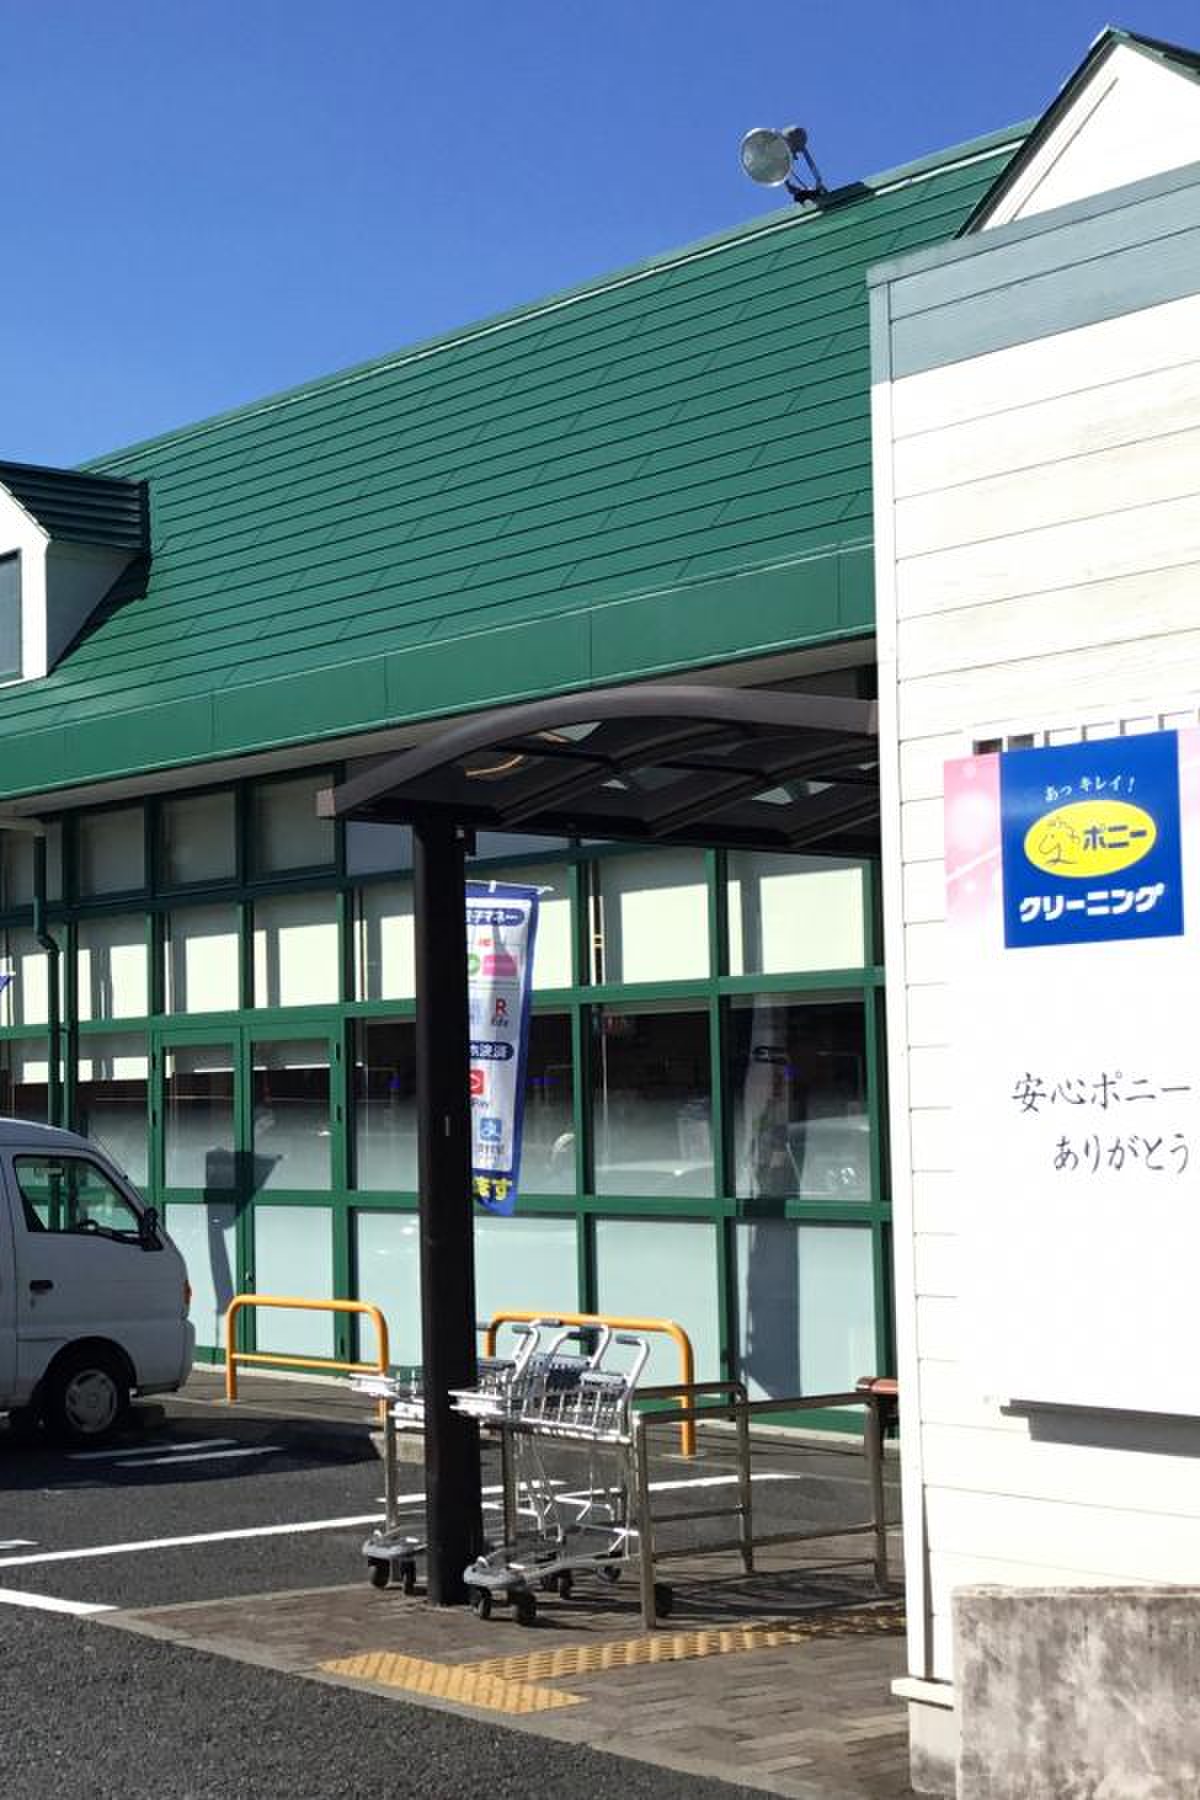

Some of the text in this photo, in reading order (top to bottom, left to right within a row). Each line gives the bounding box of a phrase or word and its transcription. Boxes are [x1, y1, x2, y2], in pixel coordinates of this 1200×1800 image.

[1082, 822, 1148, 851] ポニー
[1019, 881, 1166, 923] クリーニング
[1011, 1070, 1191, 1113] 安心ポニー
[1054, 1133, 1189, 1174] ありがとう
